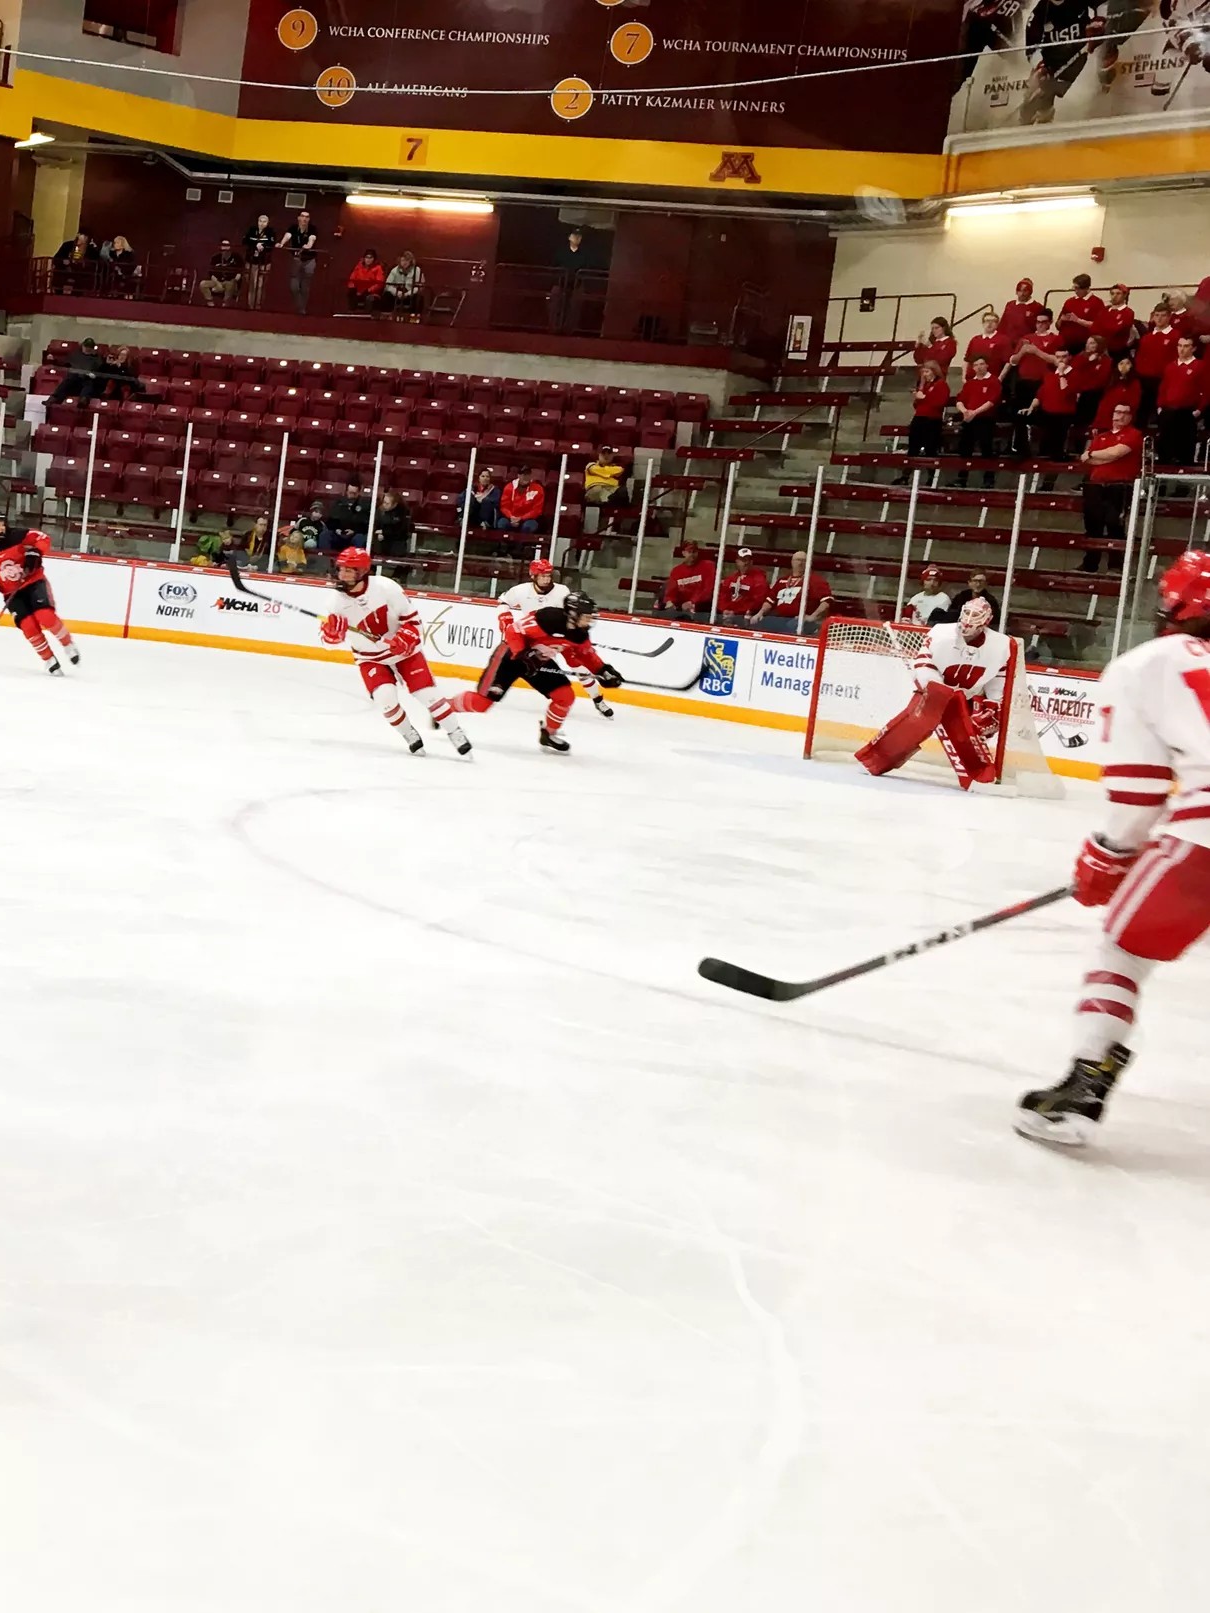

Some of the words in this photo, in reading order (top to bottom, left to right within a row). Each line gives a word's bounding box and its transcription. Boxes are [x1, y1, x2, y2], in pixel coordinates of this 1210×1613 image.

[292, 19, 306, 38] 9
[328, 25, 365, 38] WCHA
[367, 26, 445, 41] CONFERENCE
[448, 30, 550, 46] CHAMPIONSHIPS
[1049, 24, 1080, 42] USA
[624, 33, 641, 56] 7
[663, 38, 701, 51] WCHA
[704, 40, 796, 56] TOURNAMENT
[798, 45, 908, 61] CHAMPIONSHIPS
[1120, 57, 1185, 74] STEPHENS
[390, 84, 469, 98] AMERICANS
[984, 80, 1029, 94] PANNEK
[564, 88, 580, 110] 2
[601, 94, 642, 107] PATTY
[645, 96, 716, 110] KAZMAIER
[720, 99, 786, 114] WINNERS
[406, 138, 422, 161] 7
[166, 585, 189, 596] FOX
[156, 604, 195, 619] NORTH
[220, 597, 259, 612] WCHA
[447, 623, 494, 649] WICKED
[764, 649, 814, 670] Wealth
[702, 677, 731, 694] RBC
[760, 671, 861, 700] Managment
[1047, 697, 1095, 719] FACEOFF
